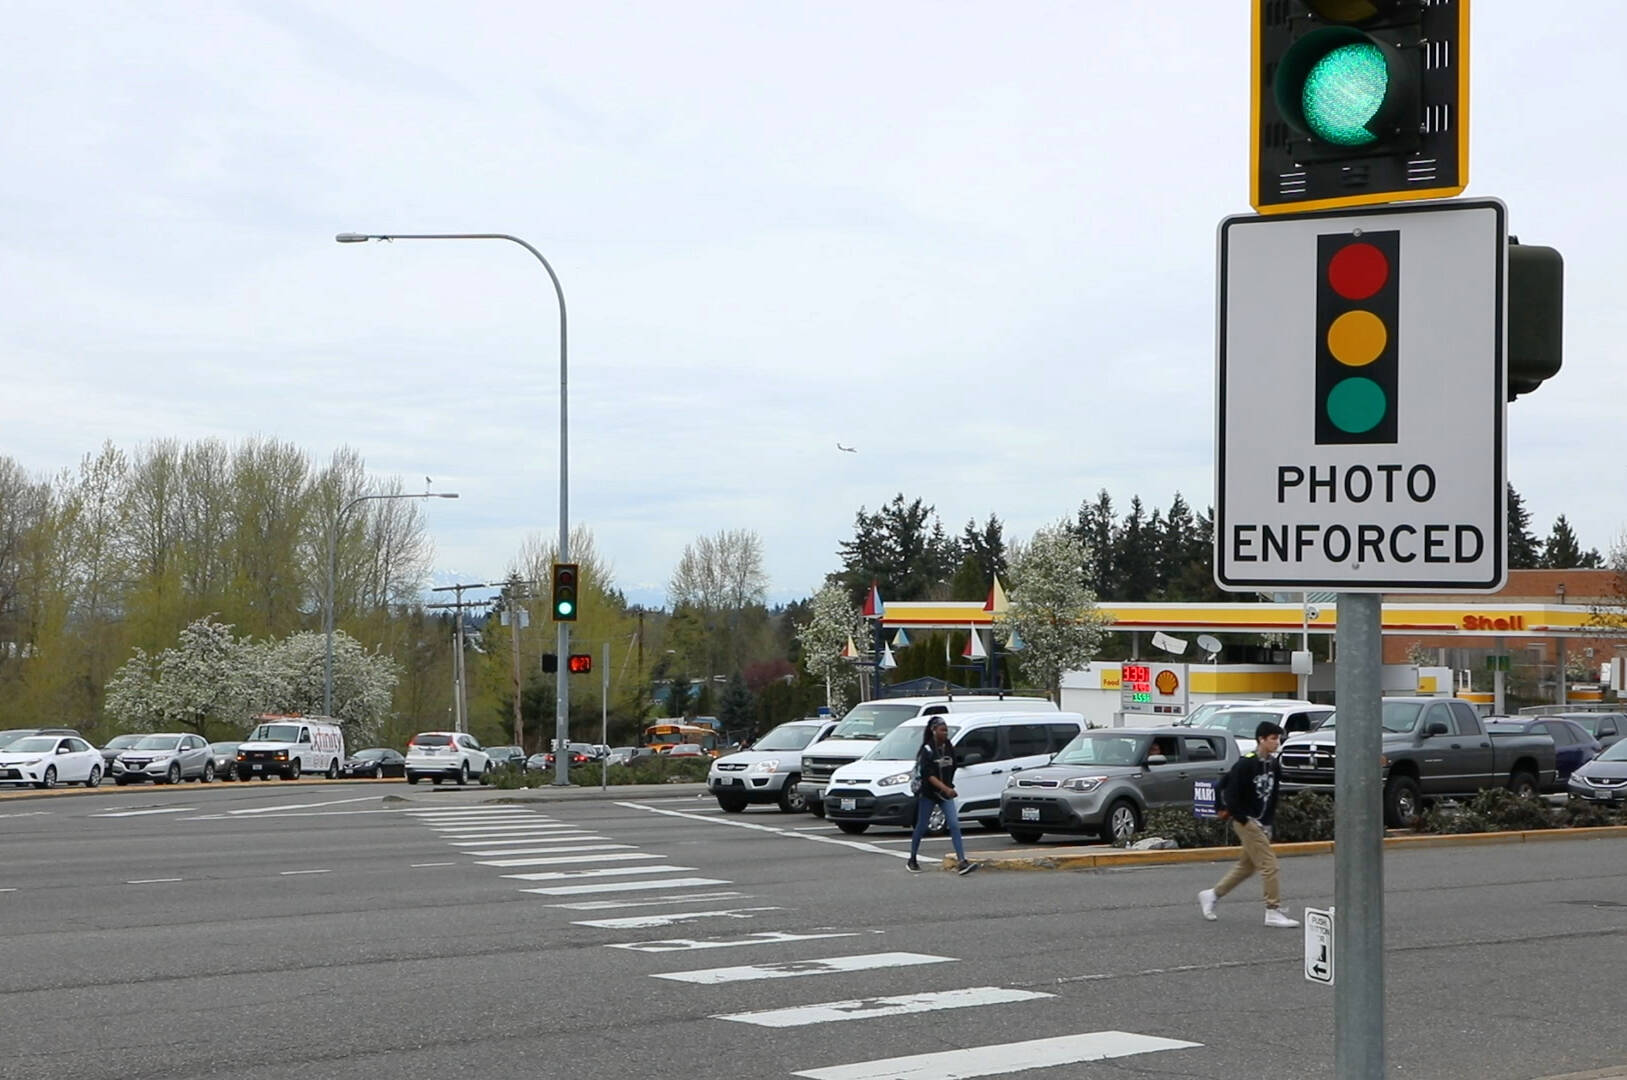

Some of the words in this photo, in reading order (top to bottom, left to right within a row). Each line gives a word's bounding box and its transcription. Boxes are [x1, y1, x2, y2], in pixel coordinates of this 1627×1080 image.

[1278, 464, 1436, 503] PHOTO
[1233, 524, 1484, 563] ENFORCED
[1462, 615, 1524, 631] Shell
